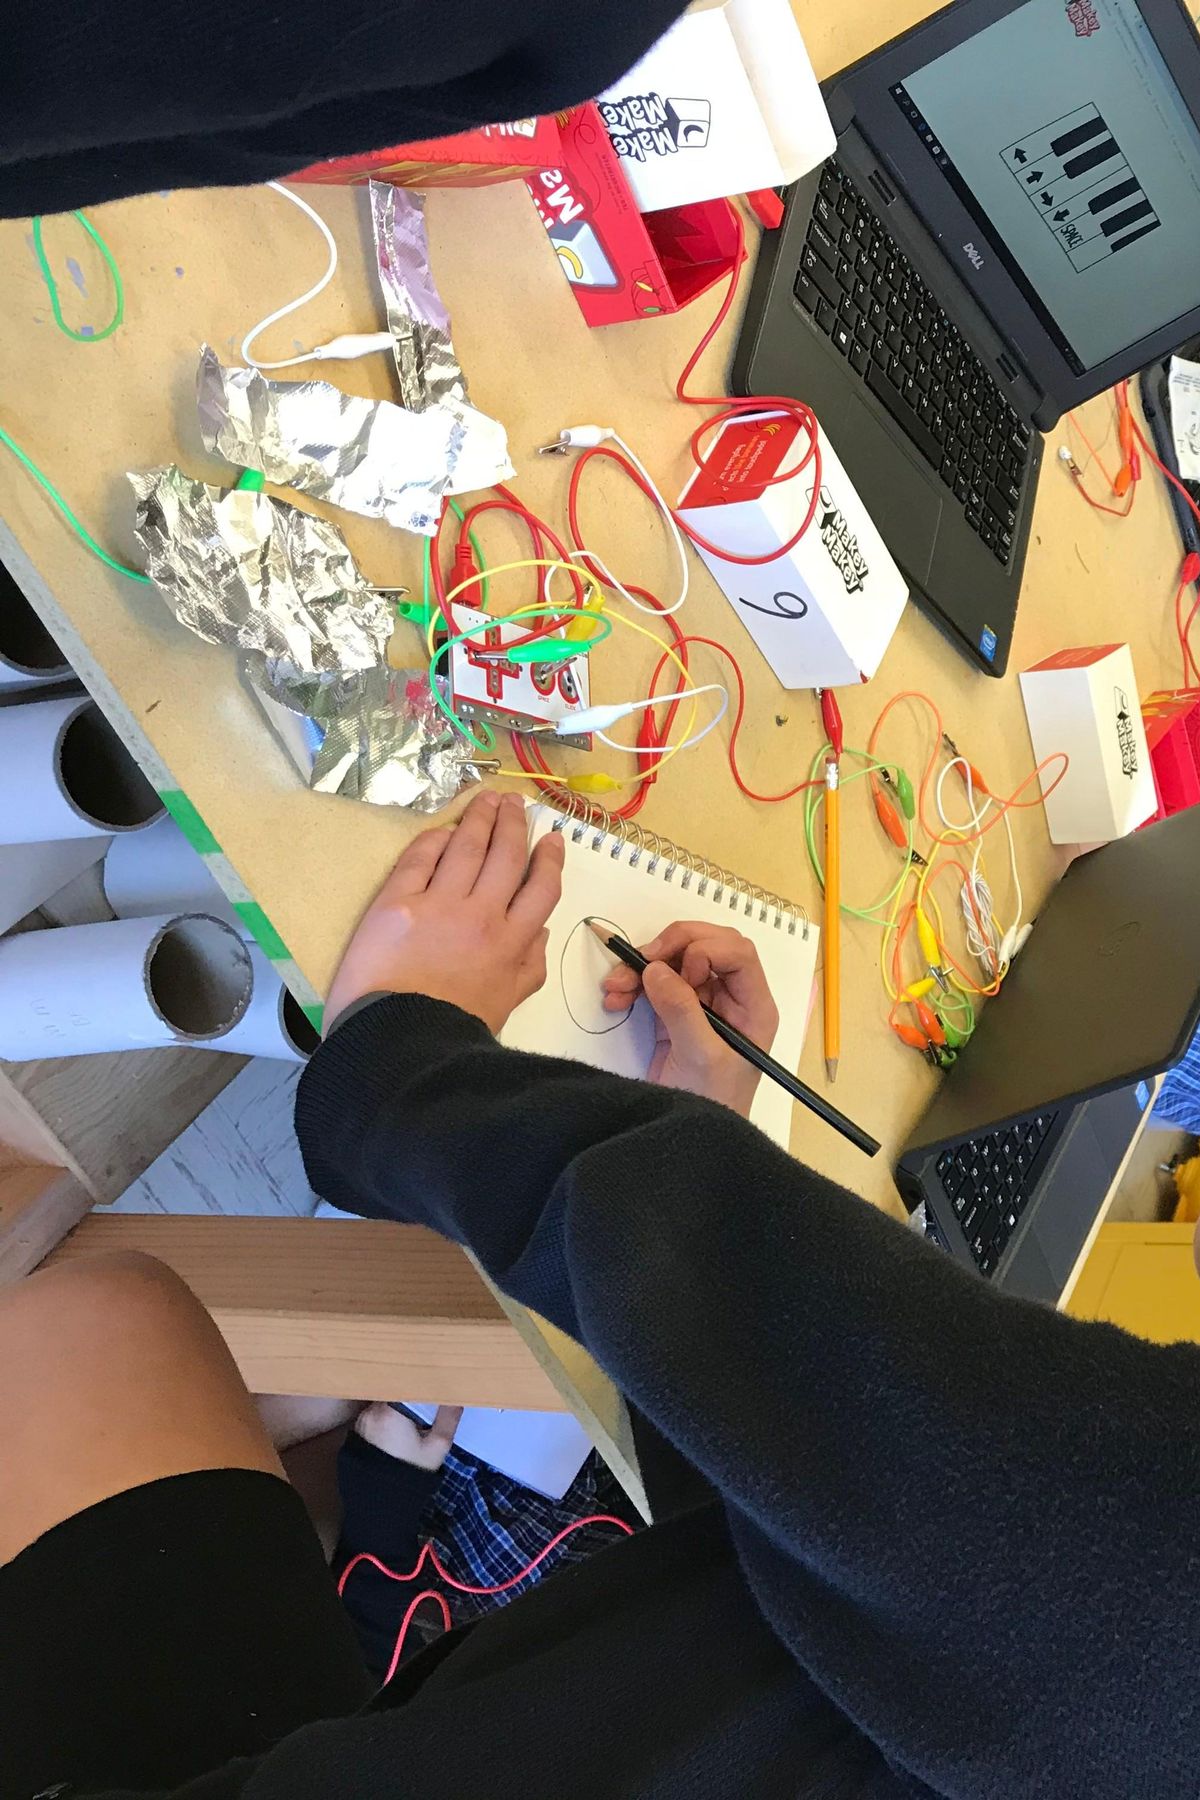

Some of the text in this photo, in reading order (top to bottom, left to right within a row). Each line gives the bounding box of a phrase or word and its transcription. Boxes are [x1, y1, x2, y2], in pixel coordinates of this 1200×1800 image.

[1066, 2, 1091, 37] Makey
[963, 243, 984, 270] DELL
[1057, 223, 1083, 249] SPACE
[822, 524, 862, 594] Makey
[832, 510, 869, 580] Makey
[739, 592, 808, 619] 9
[1116, 720, 1132, 776] Makey
[1124, 719, 1138, 774] Makey
